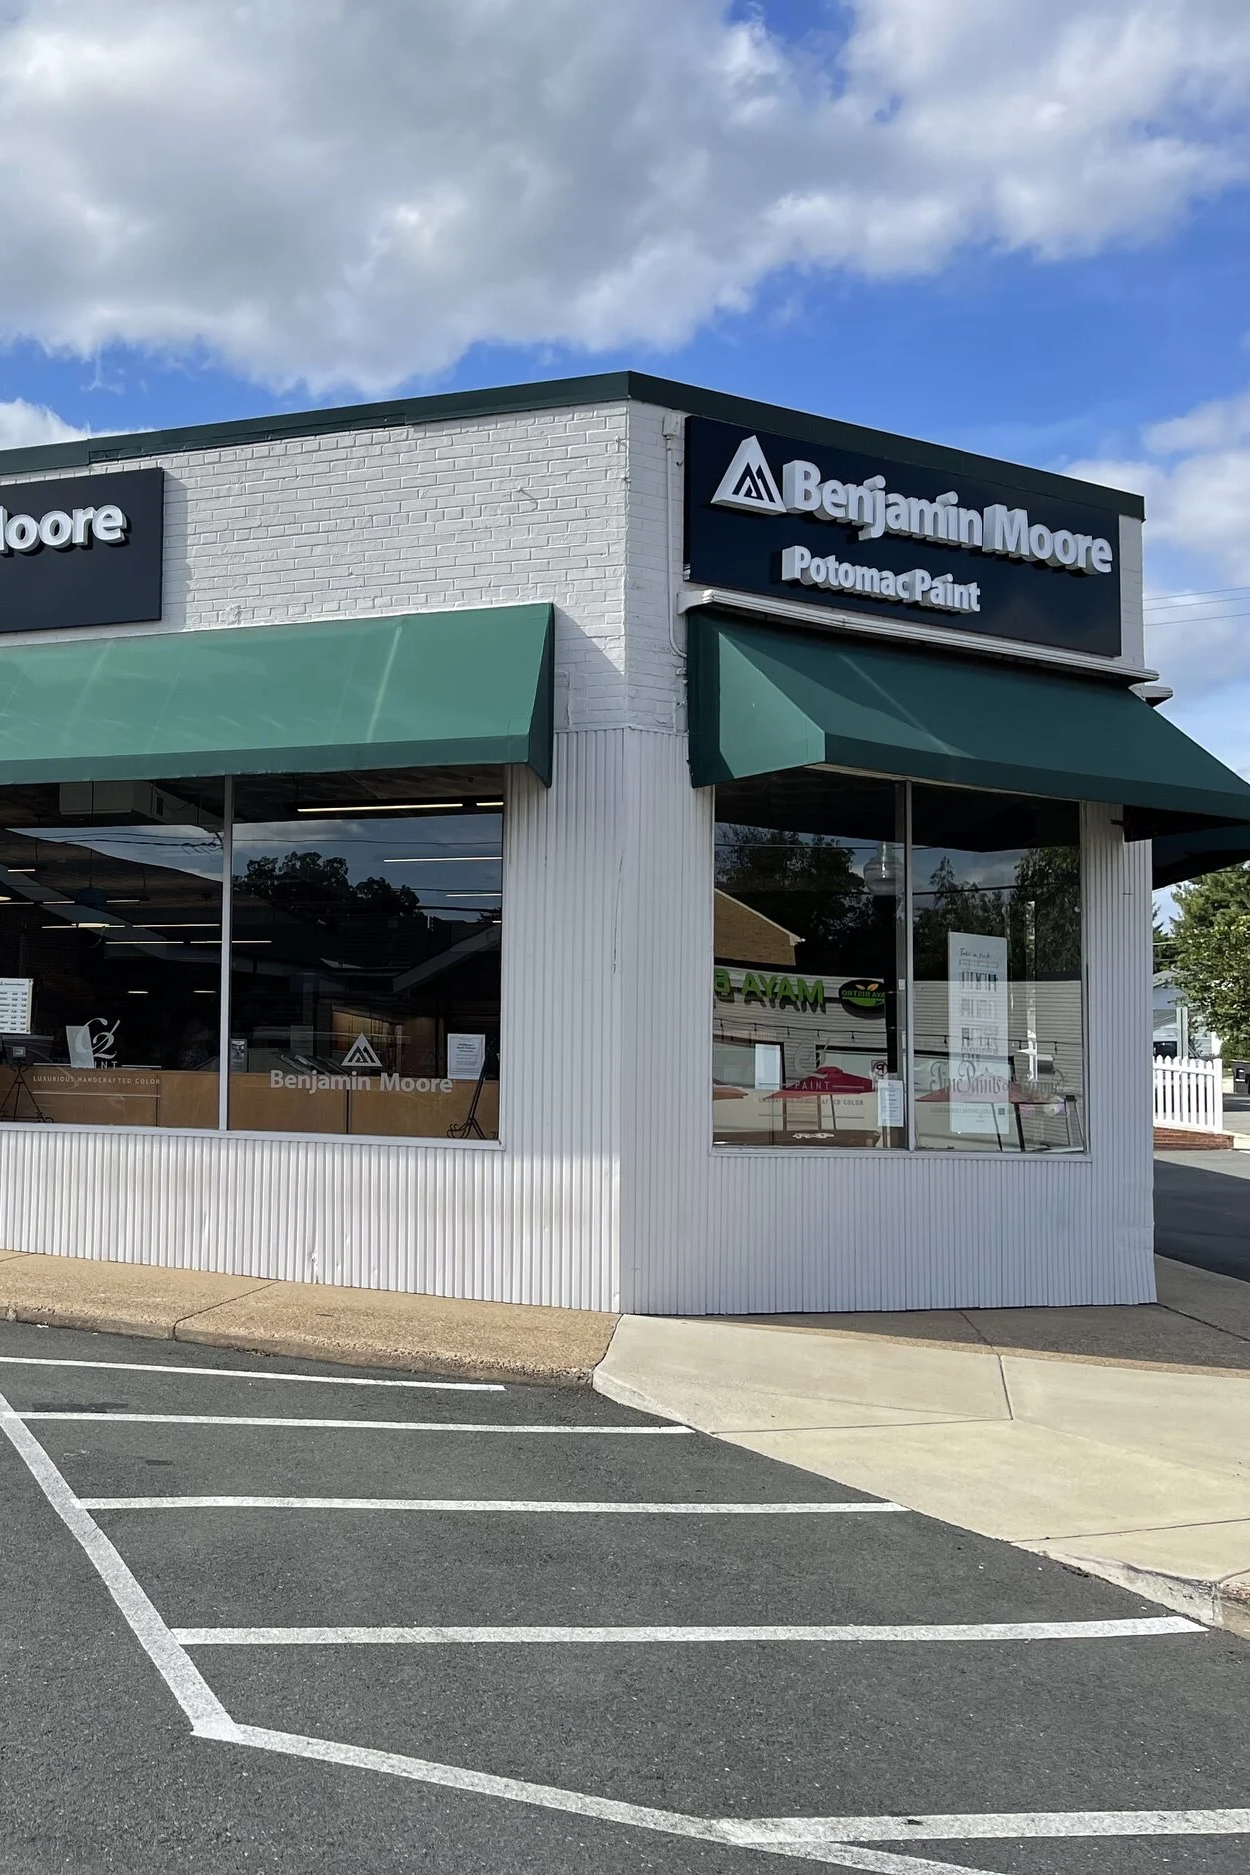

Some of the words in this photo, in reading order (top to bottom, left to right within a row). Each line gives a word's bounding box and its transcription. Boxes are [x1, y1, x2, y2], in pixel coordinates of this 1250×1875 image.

[783, 460, 982, 548] Benjamin
[983, 504, 1113, 576] Moore
[782, 545, 909, 601] Potomac
[909, 569, 981, 615] Paint
[78, 1076, 131, 1084] HANDCRAFTED
[270, 1069, 371, 1094] Benjamin
[380, 1072, 453, 1093] Moore
[795, 1080, 830, 1090] PAINT
